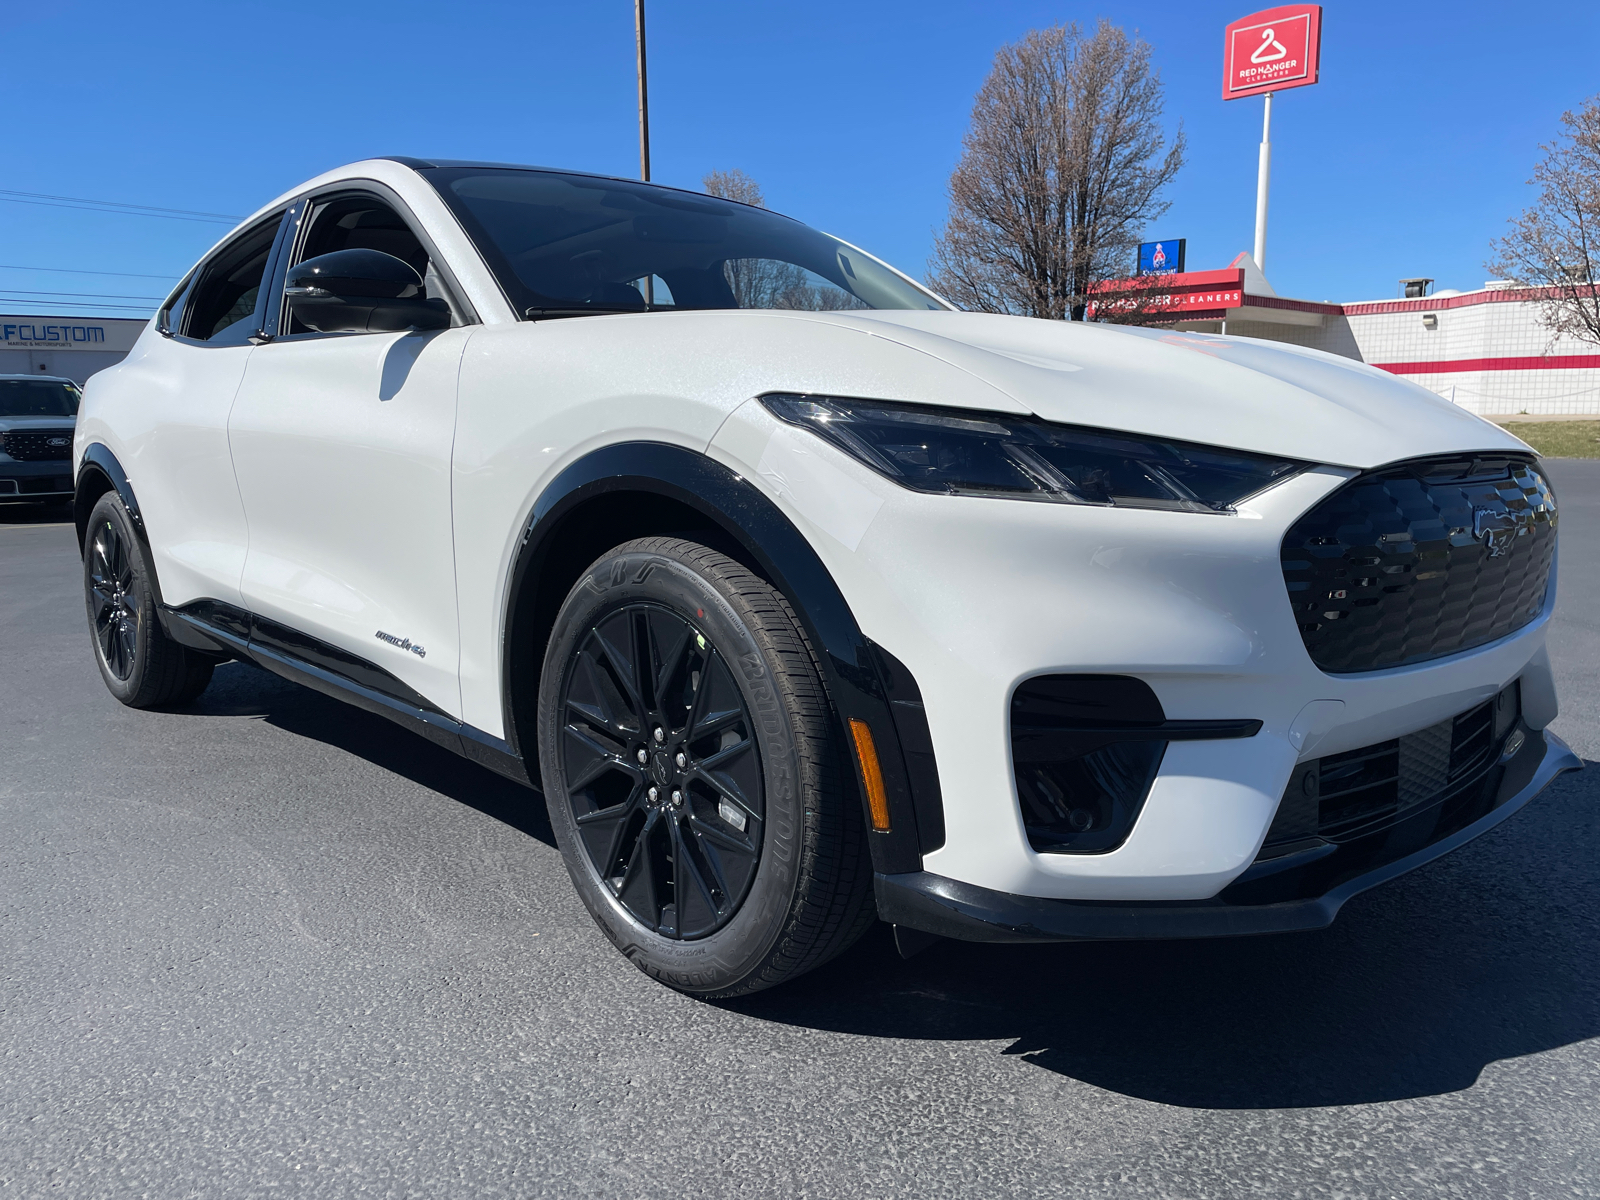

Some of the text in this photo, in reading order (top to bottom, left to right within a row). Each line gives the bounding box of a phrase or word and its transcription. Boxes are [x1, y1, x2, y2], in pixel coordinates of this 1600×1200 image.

[1240, 60, 1297, 78] RED HANGER
[1246, 70, 1289, 82] CLEANERS
[1174, 293, 1239, 305] CLEANERS
[0, 324, 105, 342] FCUSTOM
